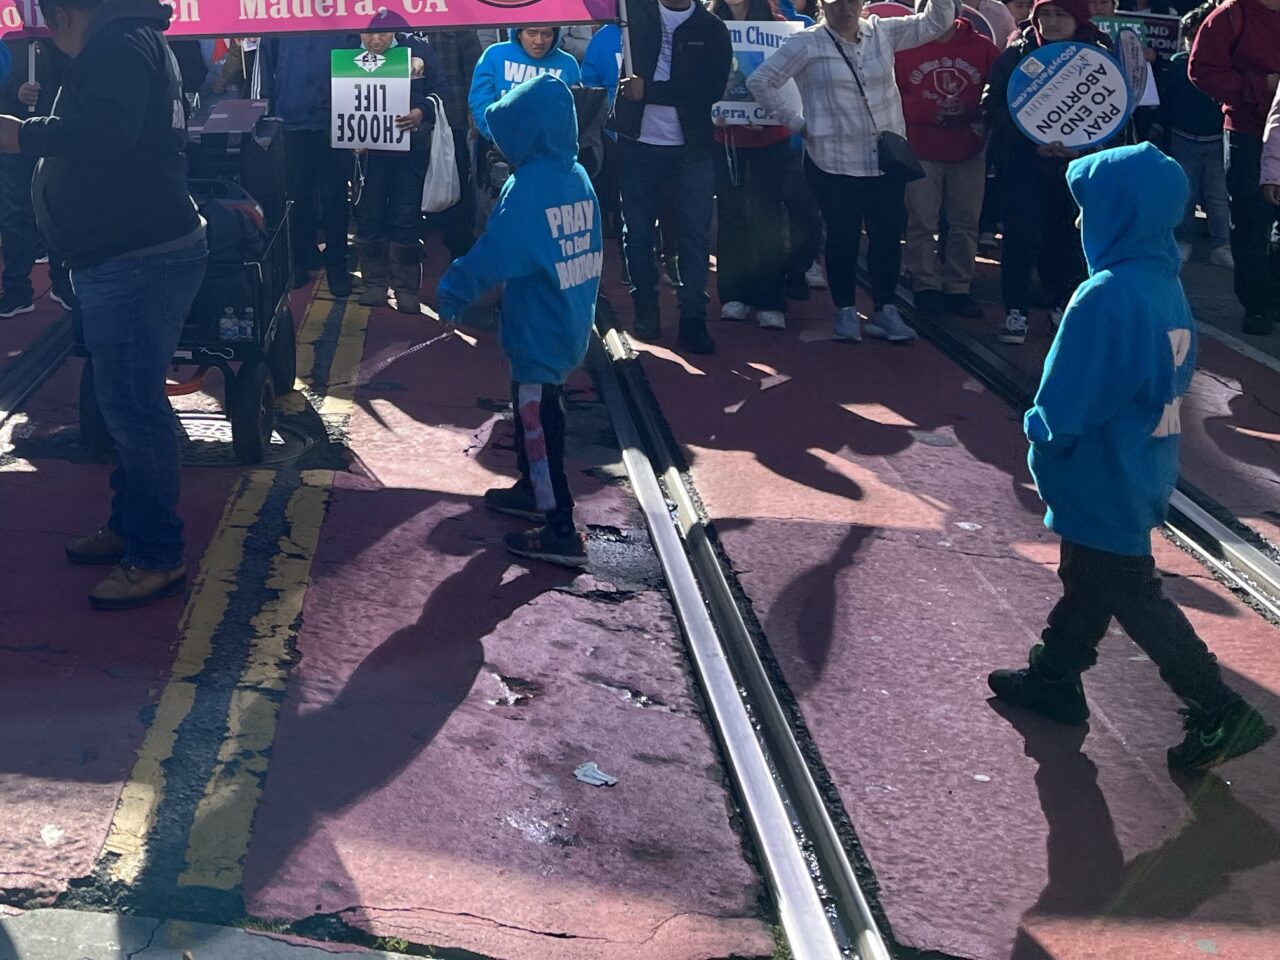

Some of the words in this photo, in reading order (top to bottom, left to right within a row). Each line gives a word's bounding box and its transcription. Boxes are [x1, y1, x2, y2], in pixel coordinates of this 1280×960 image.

[354, 84, 386, 112] LIFE
[1035, 63, 1108, 135] ABORTION
[1091, 85, 1116, 106] TO
[337, 113, 405, 144] CHOOSE
[1060, 106, 1093, 136] END
[1083, 102, 1121, 140] PRAY
[545, 200, 593, 238] PRAY
[559, 239, 573, 256] To
[574, 232, 591, 254] End
